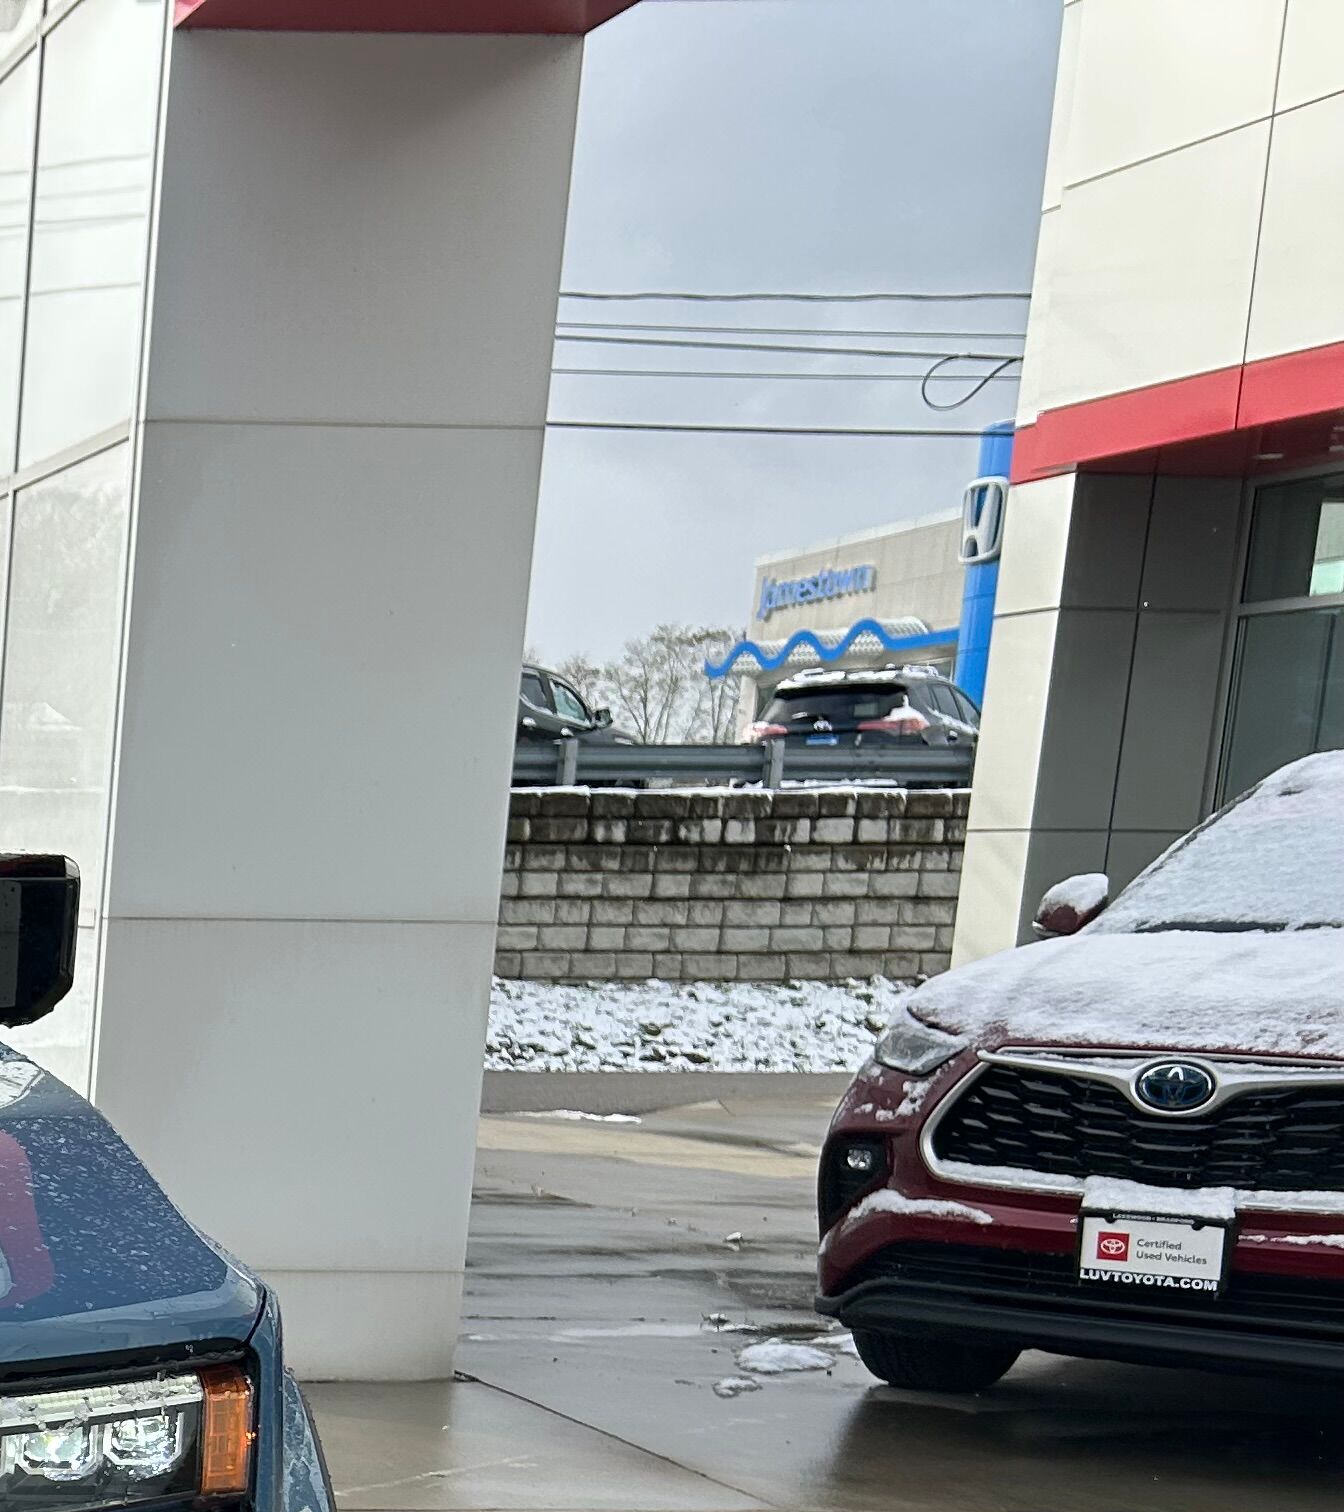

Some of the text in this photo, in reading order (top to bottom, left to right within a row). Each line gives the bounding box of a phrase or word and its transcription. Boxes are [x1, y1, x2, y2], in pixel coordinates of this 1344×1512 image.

[1136, 1238, 1182, 1251] Certified
[1136, 1251, 1207, 1265] Used Vehicles
[1080, 1268, 1218, 1291] LUVTOYOTA.COM
